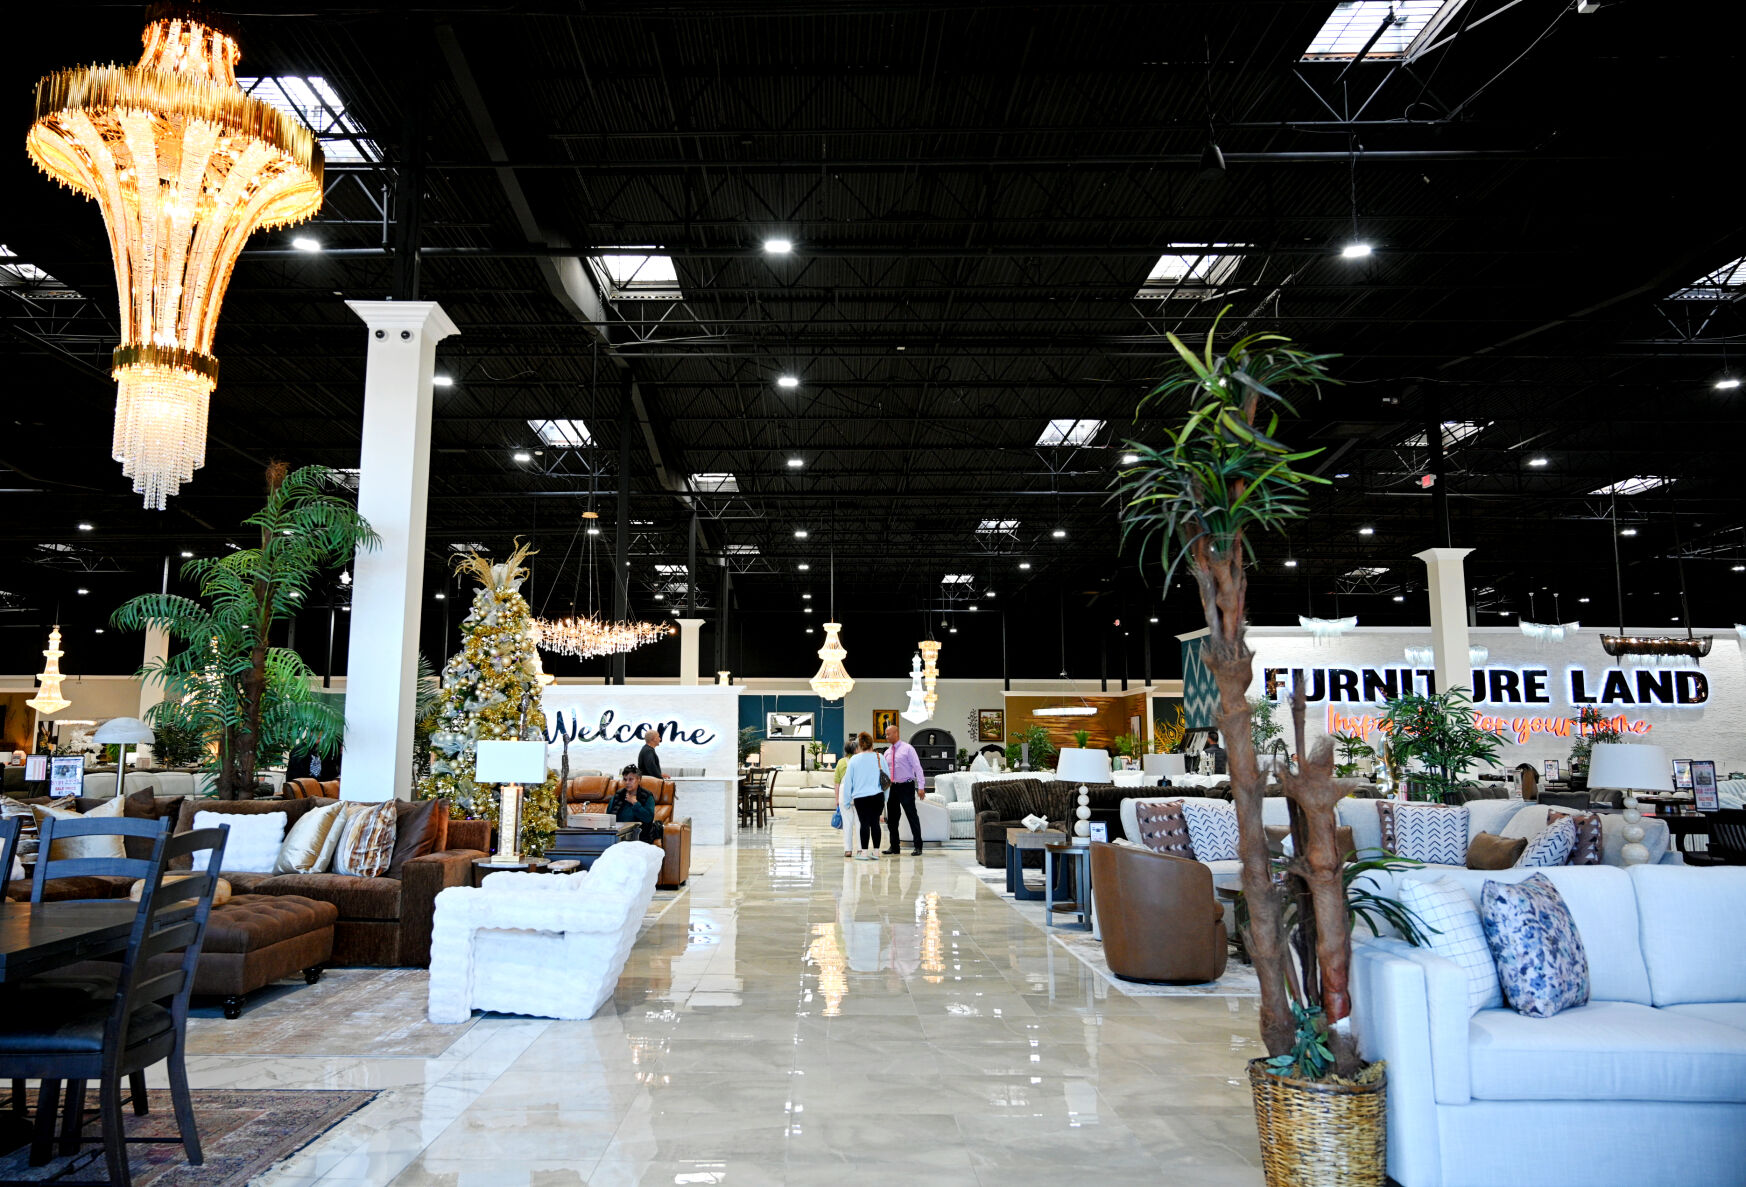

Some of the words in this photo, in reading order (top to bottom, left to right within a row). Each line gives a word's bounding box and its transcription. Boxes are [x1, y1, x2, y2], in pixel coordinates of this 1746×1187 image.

[1571, 670, 1709, 704] LAND
[542, 708, 716, 745] Welcome
[1512, 715, 1578, 744] your
